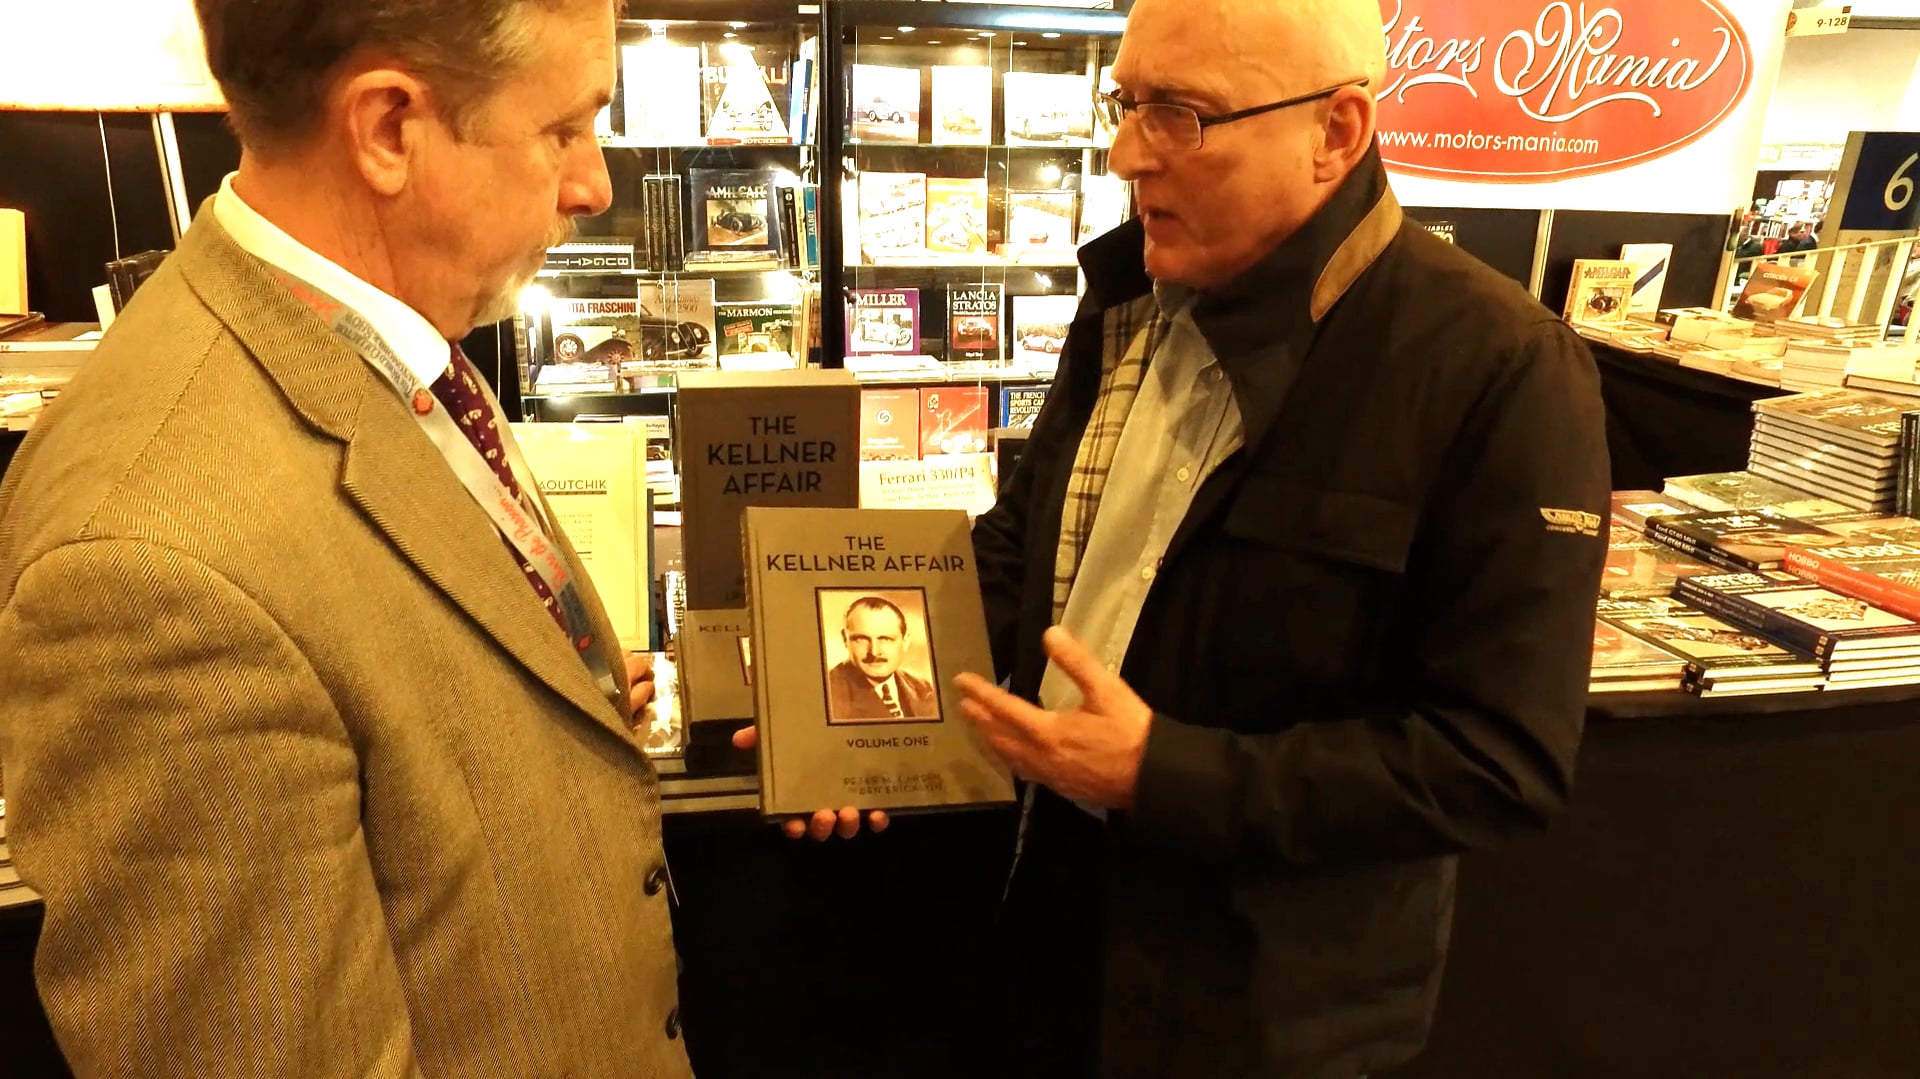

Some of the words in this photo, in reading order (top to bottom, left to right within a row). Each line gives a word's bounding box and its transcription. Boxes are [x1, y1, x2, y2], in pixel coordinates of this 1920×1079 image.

[1817, 17, 1848, 28] 9-128
[1493, 1, 1731, 122] Mania
[1378, 130, 1599, 154] www.motors-mania.com
[1884, 151, 1919, 211] 6
[708, 185, 767, 199] AMILCAR
[807, 210, 815, 236] TALBOT
[546, 256, 629, 267] BUGATTI
[1584, 266, 1631, 279] AMILCAR
[857, 293, 907, 306] MILLER
[953, 290, 996, 301] LANCIA
[587, 302, 637, 314] FRASCHINI
[727, 307, 773, 318] MARMON
[952, 301, 997, 310] STRATOS
[1010, 391, 1022, 399] THE
[1010, 399, 1032, 407] SPORTS
[749, 416, 796, 435] THE
[708, 441, 836, 465] KELLNER
[723, 471, 822, 495] AFFAIR
[879, 471, 926, 486] Ferrari
[930, 466, 976, 482] 330/P4
[539, 480, 607, 490] AOUTCHIK
[844, 536, 886, 551] THE
[767, 554, 876, 572] KELLNER
[884, 555, 966, 572] AFFAIR
[1788, 551, 1820, 569] HOBBO
[699, 624, 743, 633] KELL
[846, 737, 900, 749] VOLUME
[903, 735, 929, 746] ONE
